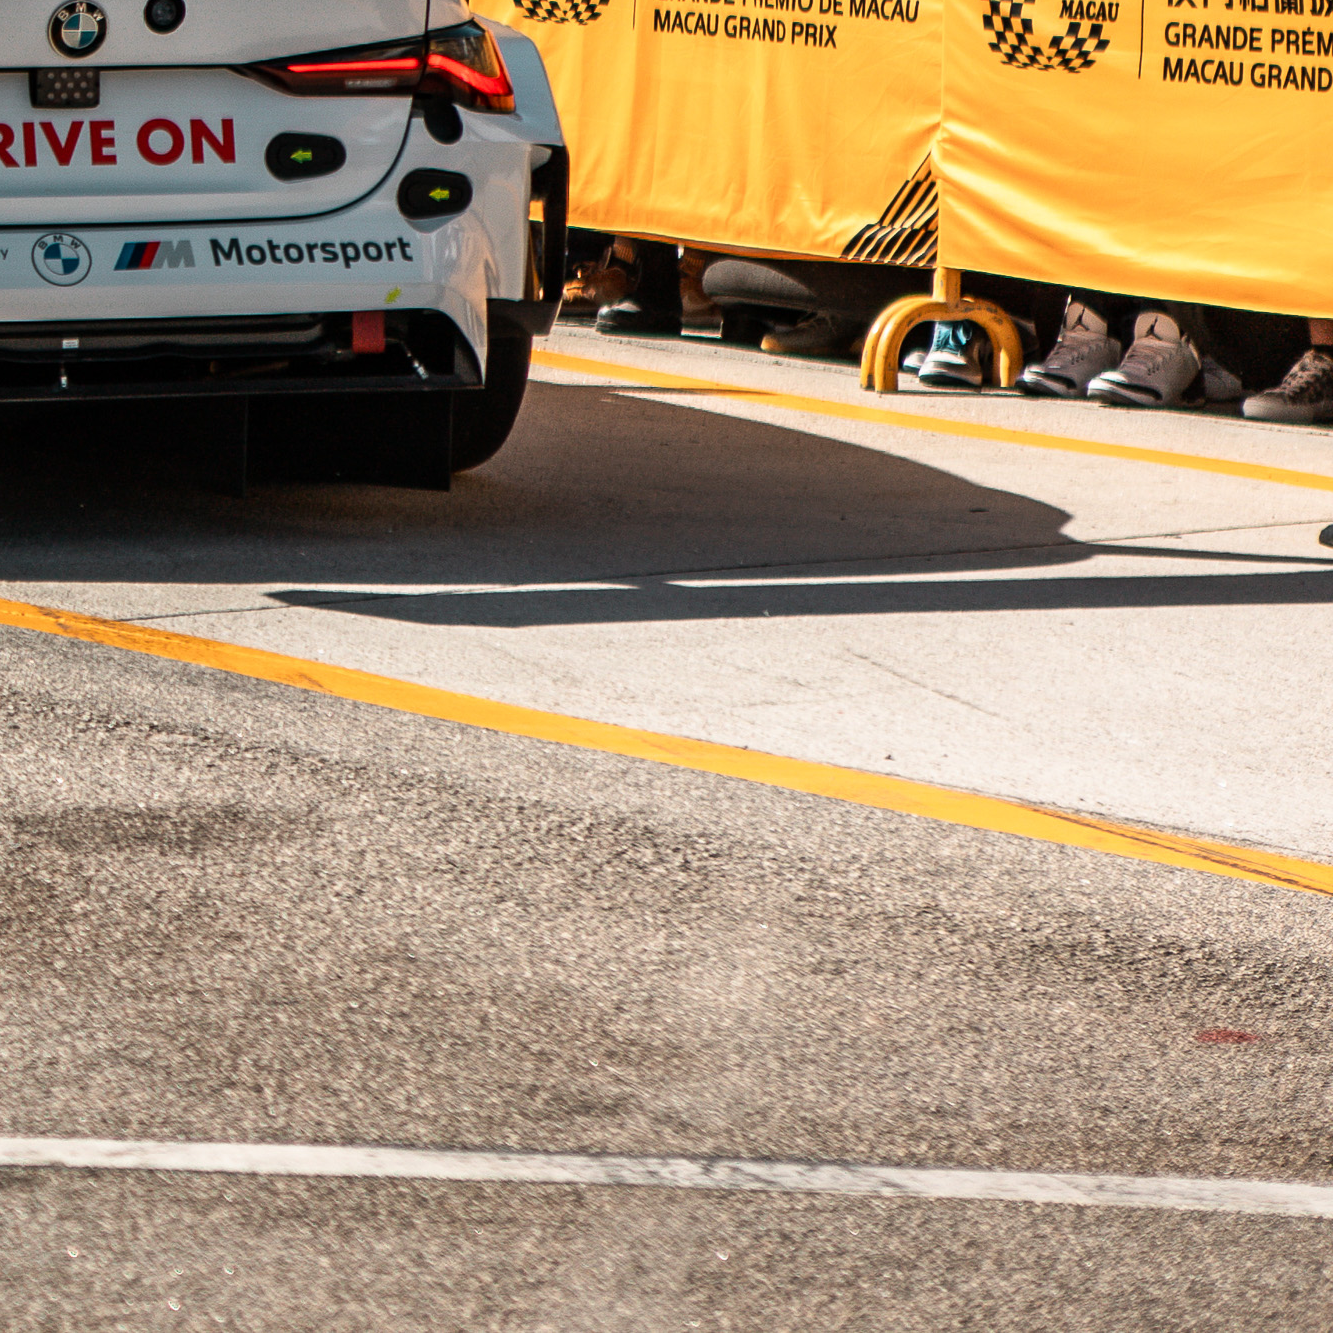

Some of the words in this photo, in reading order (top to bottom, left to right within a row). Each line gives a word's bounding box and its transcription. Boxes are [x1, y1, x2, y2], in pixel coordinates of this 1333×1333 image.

[1059, 0, 1120, 22] MACAU
[654, 9, 720, 37] MACAU
[724, 15, 787, 44] GRAND
[791, 21, 838, 50] PRIX
[1164, 21, 1264, 53] GRANDE
[1163, 57, 1244, 87] MACAU
[1251, 62, 1333, 93] GRAND
[136, 118, 236, 167] ON
[209, 237, 413, 269] Motorsport
